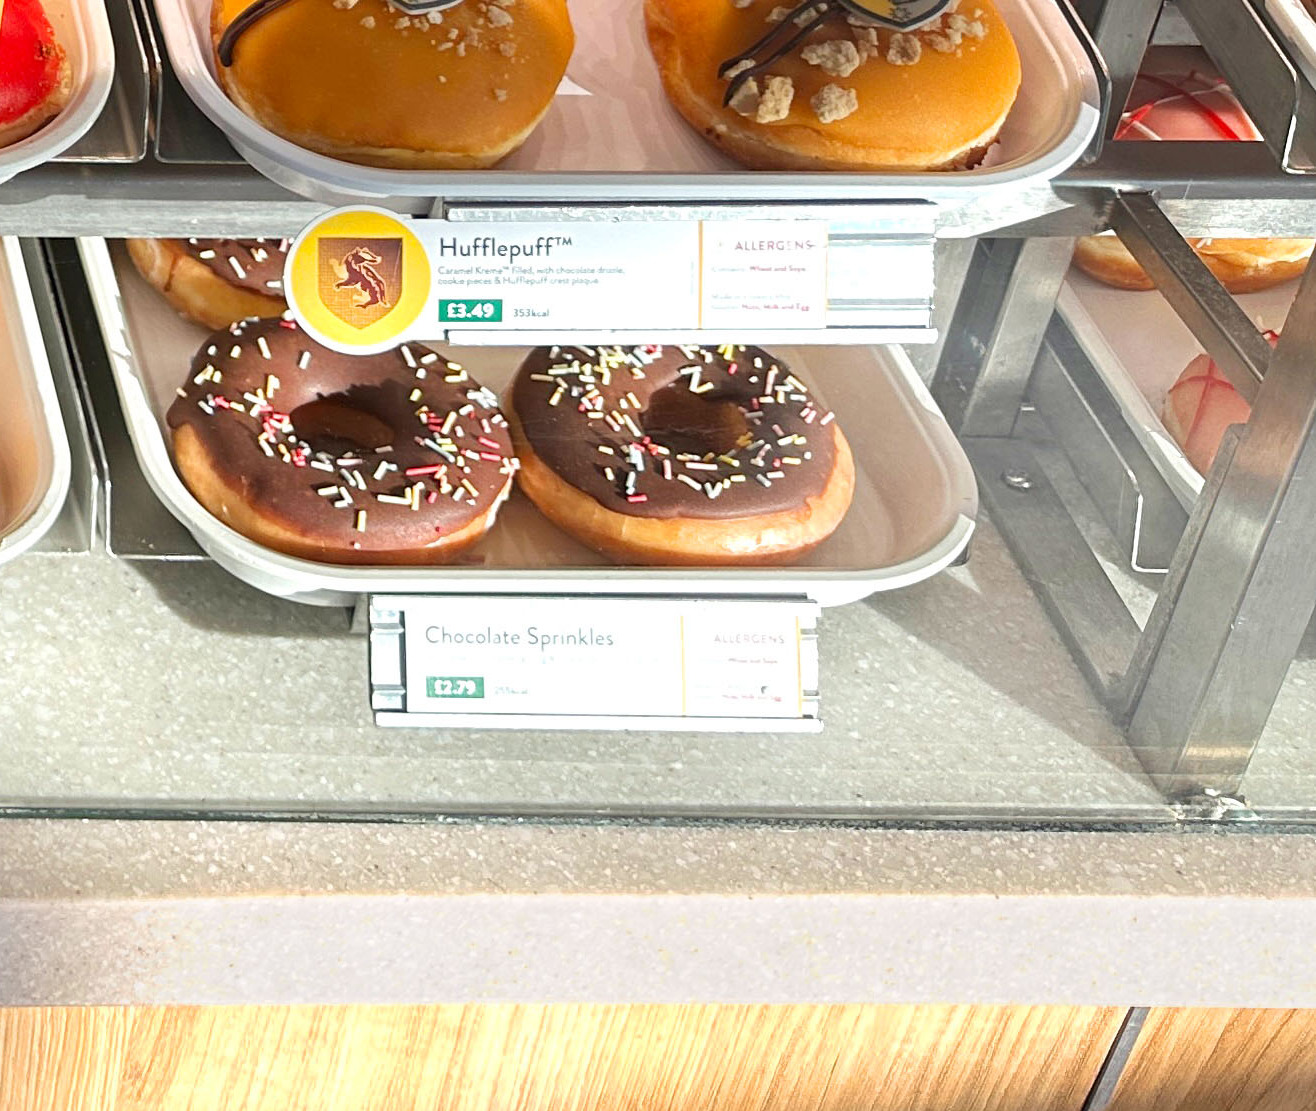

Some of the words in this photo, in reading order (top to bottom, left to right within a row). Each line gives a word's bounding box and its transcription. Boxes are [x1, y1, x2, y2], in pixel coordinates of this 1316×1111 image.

[734, 240, 812, 251] ALLERGENS
[446, 302, 495, 319] £3.49
[513, 308, 550, 318] 353kcal
[425, 625, 520, 645] Chocolate
[527, 626, 614, 652] Sprinkles
[434, 679, 477, 695] £2.79
